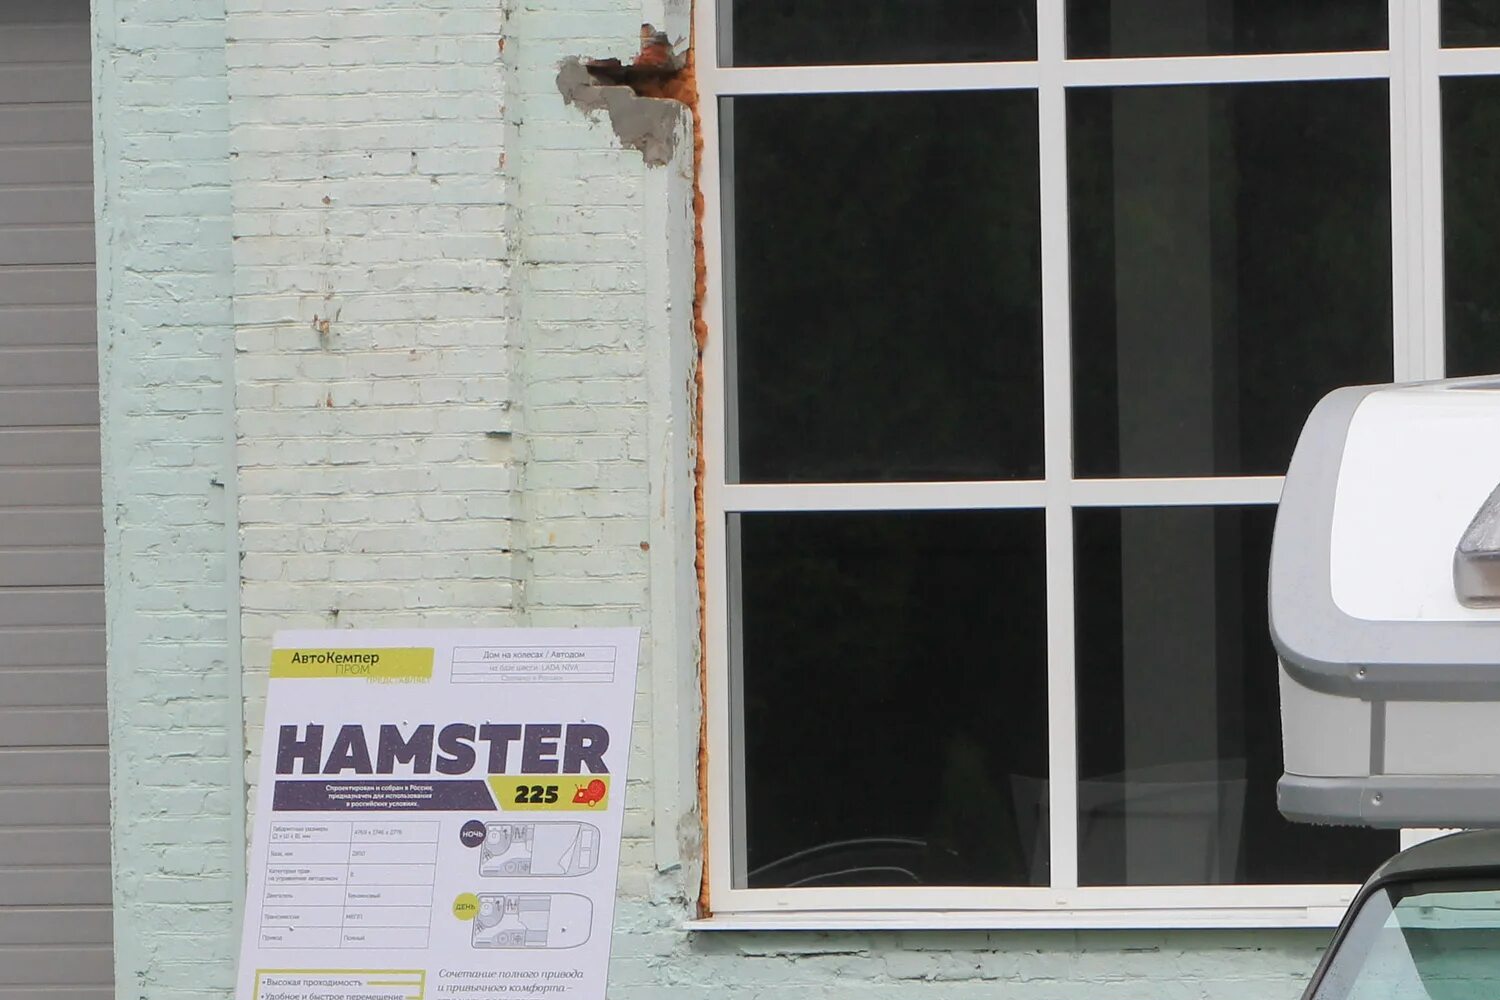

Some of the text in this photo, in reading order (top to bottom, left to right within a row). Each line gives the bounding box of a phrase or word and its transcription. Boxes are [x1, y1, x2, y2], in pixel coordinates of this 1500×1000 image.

[291, 652, 380, 666] АвтоКемпер
[483, 651, 500, 659] Дом
[550, 651, 585, 660] Автодом
[335, 664, 371, 674] ПРОМ
[541, 663, 560, 671] LADA
[561, 663, 579, 671] NIVA
[275, 723, 611, 775] HAMSTER
[514, 785, 559, 804] 225
[439, 968, 584, 980] Сочетание полного привода
[266, 978, 363, 988] Высокая проходимость
[446, 984, 507, 994] привычного
[508, 982, 565, 994] комфорта
[265, 992, 300, 1000] Удобное
